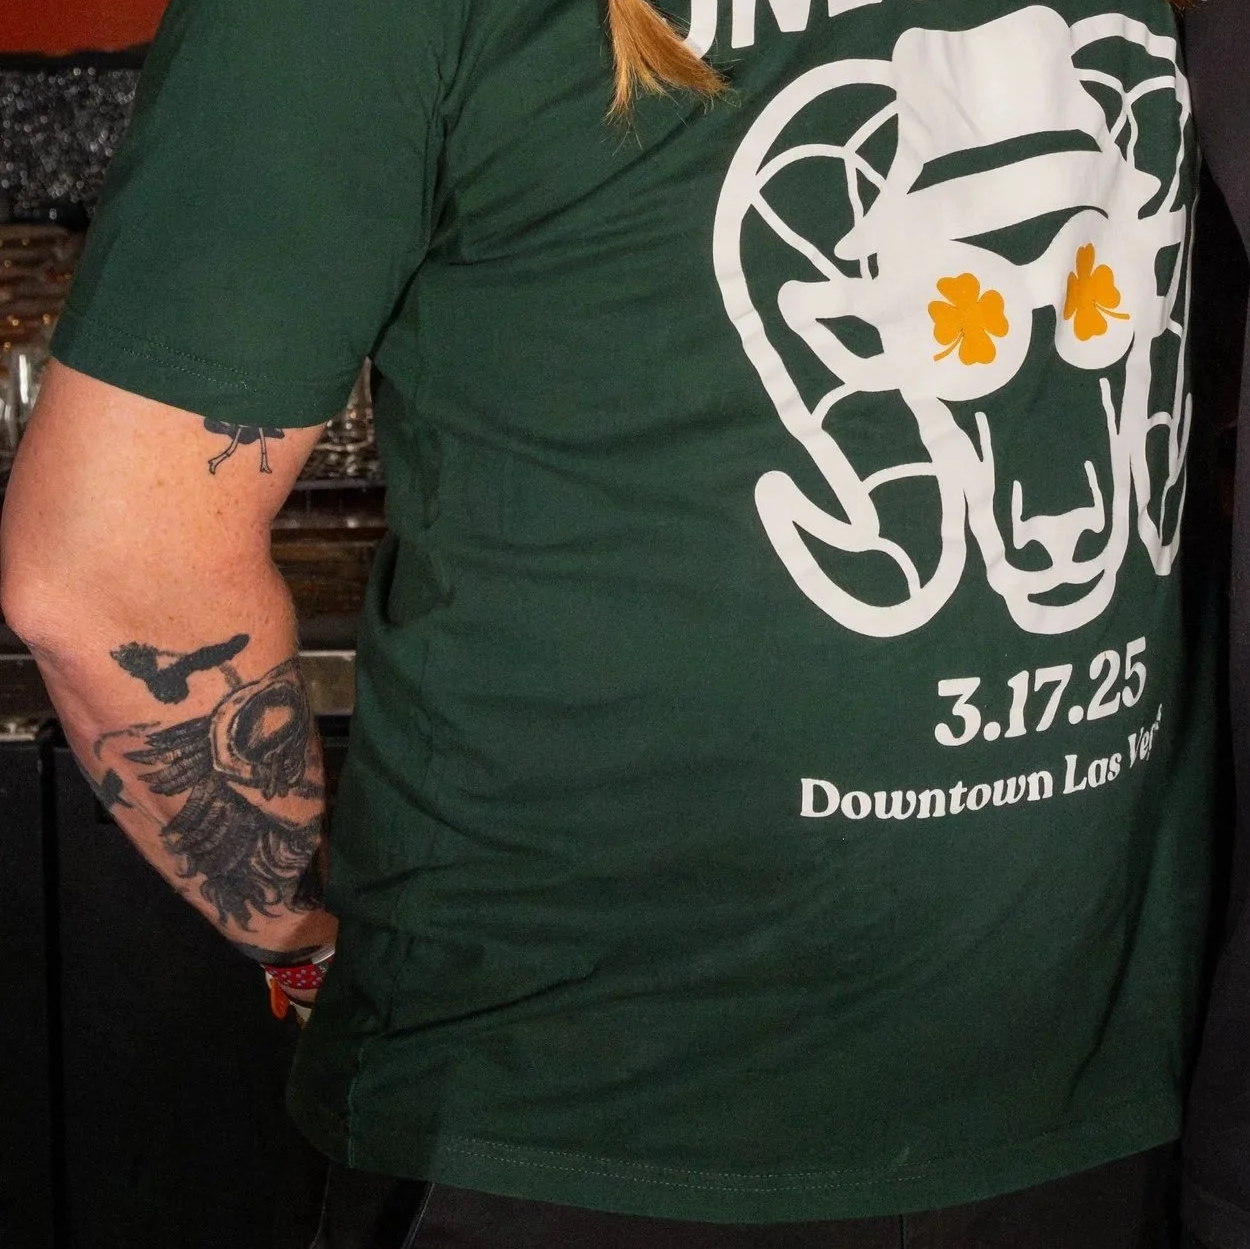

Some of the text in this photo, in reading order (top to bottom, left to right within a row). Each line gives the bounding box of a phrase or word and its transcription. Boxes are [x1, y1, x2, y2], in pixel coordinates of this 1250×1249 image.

[935, 636, 1147, 746] 3.17.25
[800, 752, 1122, 819] Downtown Las
